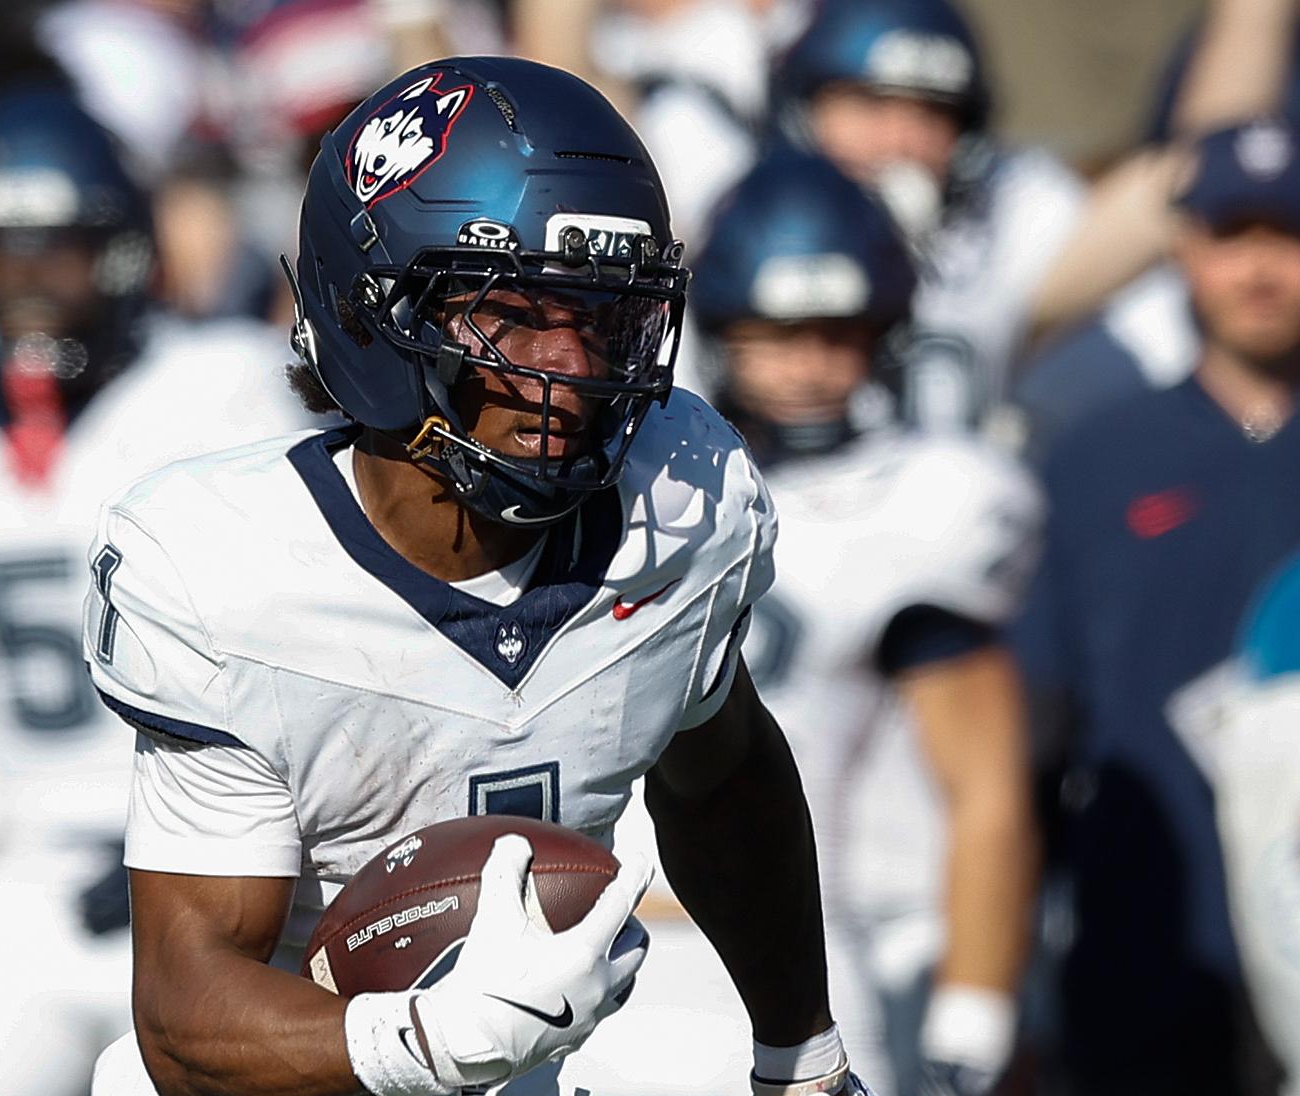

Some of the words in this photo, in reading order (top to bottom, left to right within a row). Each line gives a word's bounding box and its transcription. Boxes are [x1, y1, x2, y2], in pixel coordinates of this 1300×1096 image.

[458, 235, 518, 250] OAKLEY
[91, 543, 124, 666] 1
[392, 895, 459, 927] VAPOR
[346, 916, 394, 952] ELITE
